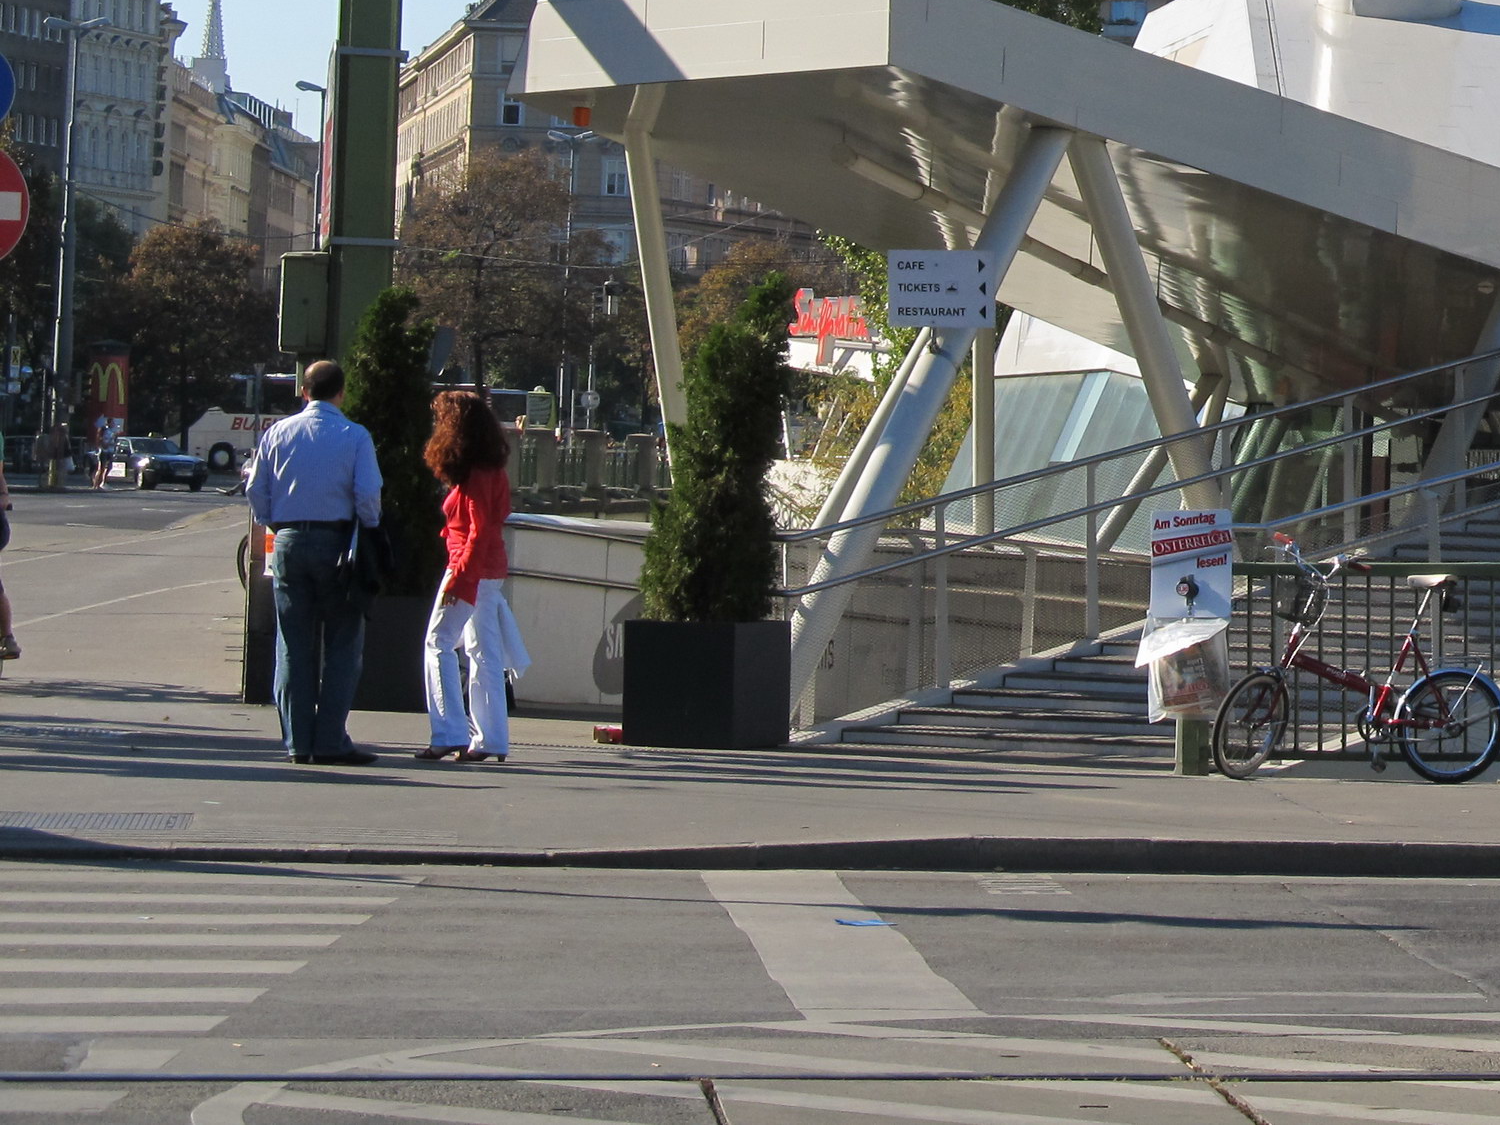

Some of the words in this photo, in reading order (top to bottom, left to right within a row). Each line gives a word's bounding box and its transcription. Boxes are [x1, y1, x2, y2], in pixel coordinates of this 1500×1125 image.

[897, 261, 925, 270] CAFE
[898, 283, 941, 293] TICKETS
[897, 307, 966, 317] RESTAURANT
[1153, 519, 1171, 530] Am
[1173, 513, 1217, 527] Sonntag
[1196, 553, 1228, 569] lesen!
